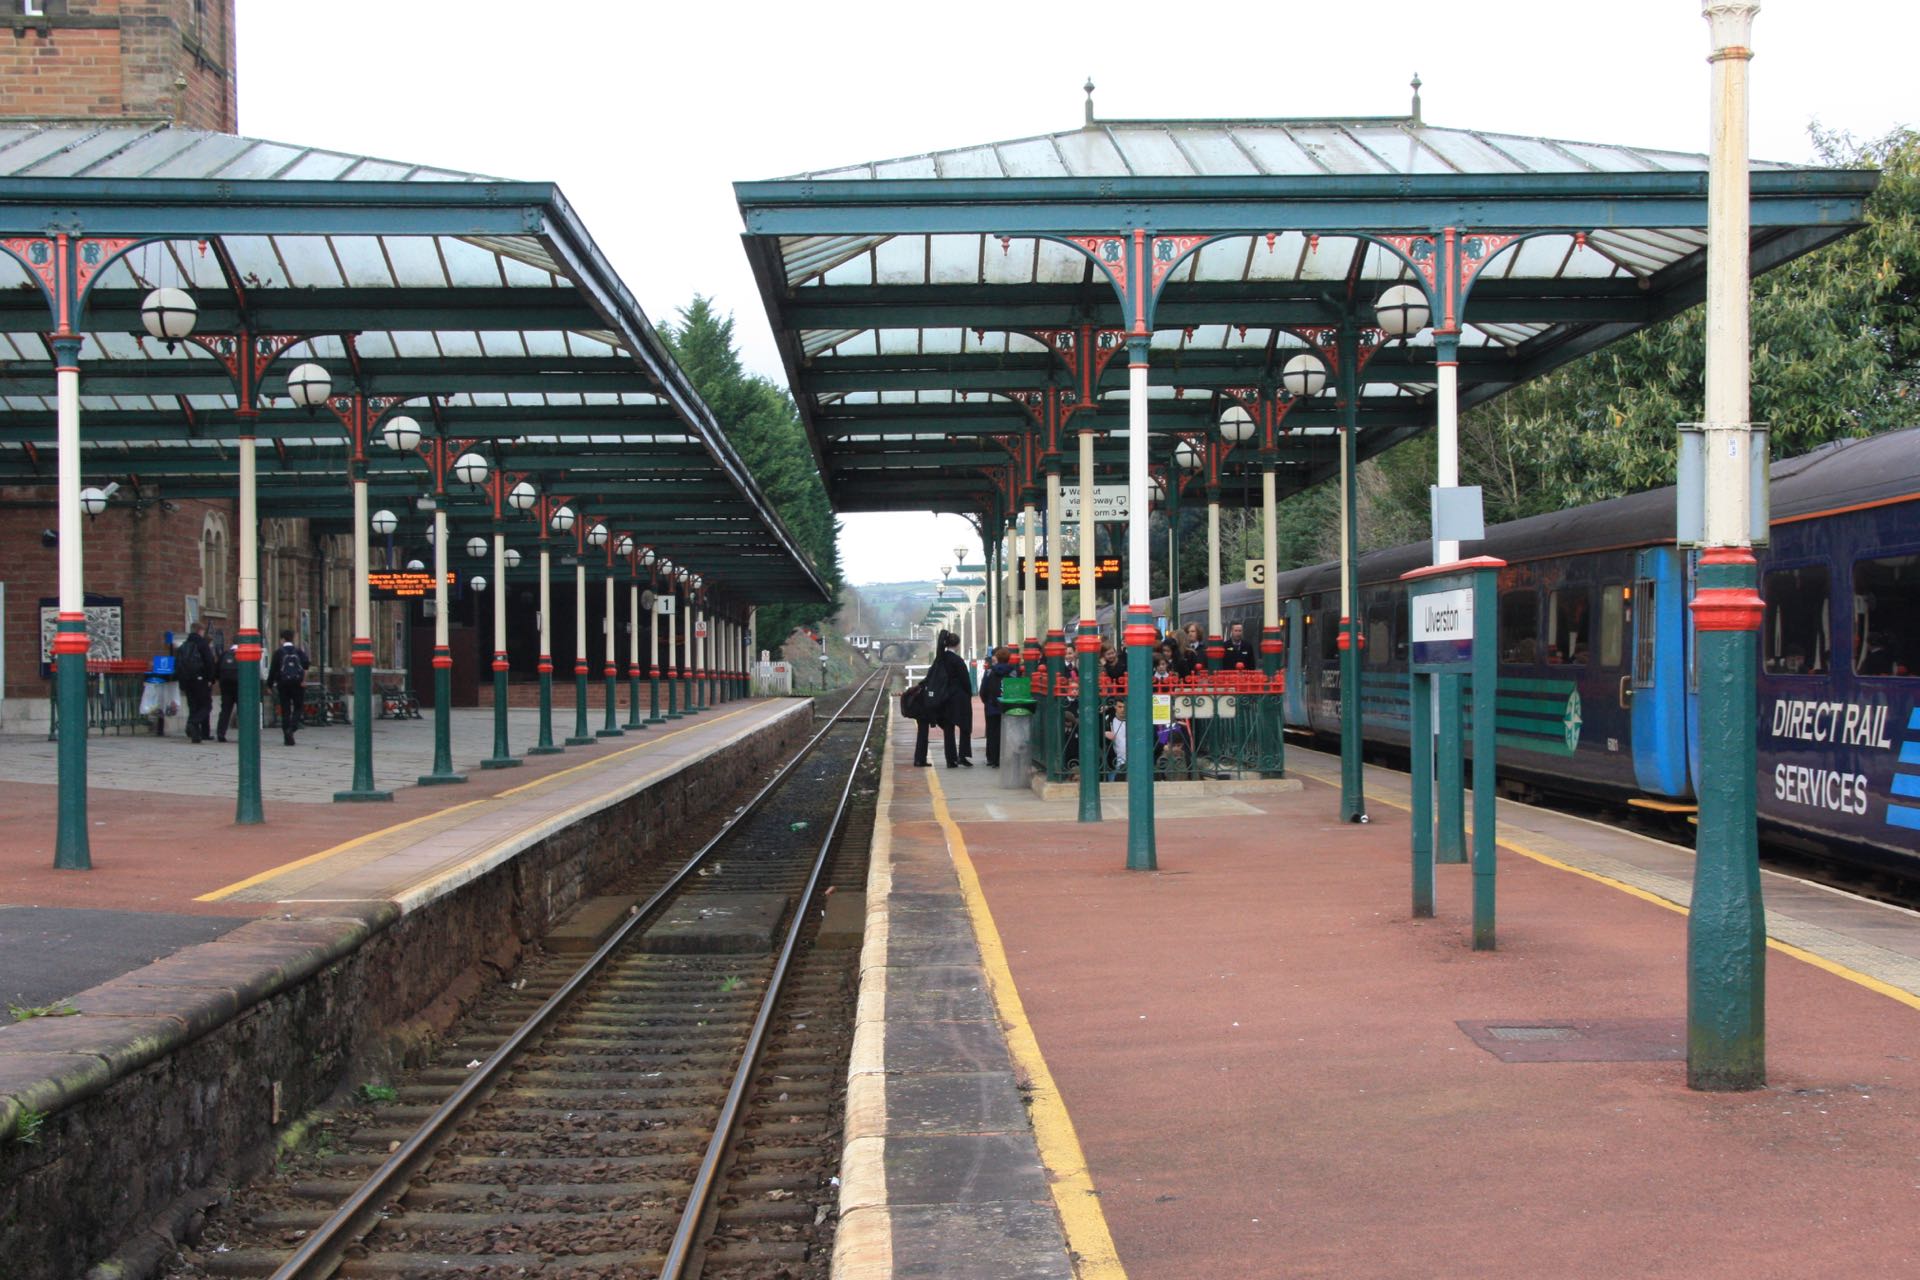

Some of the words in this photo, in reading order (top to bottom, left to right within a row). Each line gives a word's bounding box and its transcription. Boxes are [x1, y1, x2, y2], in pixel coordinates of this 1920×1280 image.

[1252, 564, 1265, 585] 3
[663, 598, 669, 611] 1
[1424, 603, 1460, 633] Ulverston
[1771, 699, 1844, 743] DIRECT
[1841, 703, 1892, 749] RAIL
[1774, 763, 1868, 815] SERVICES
